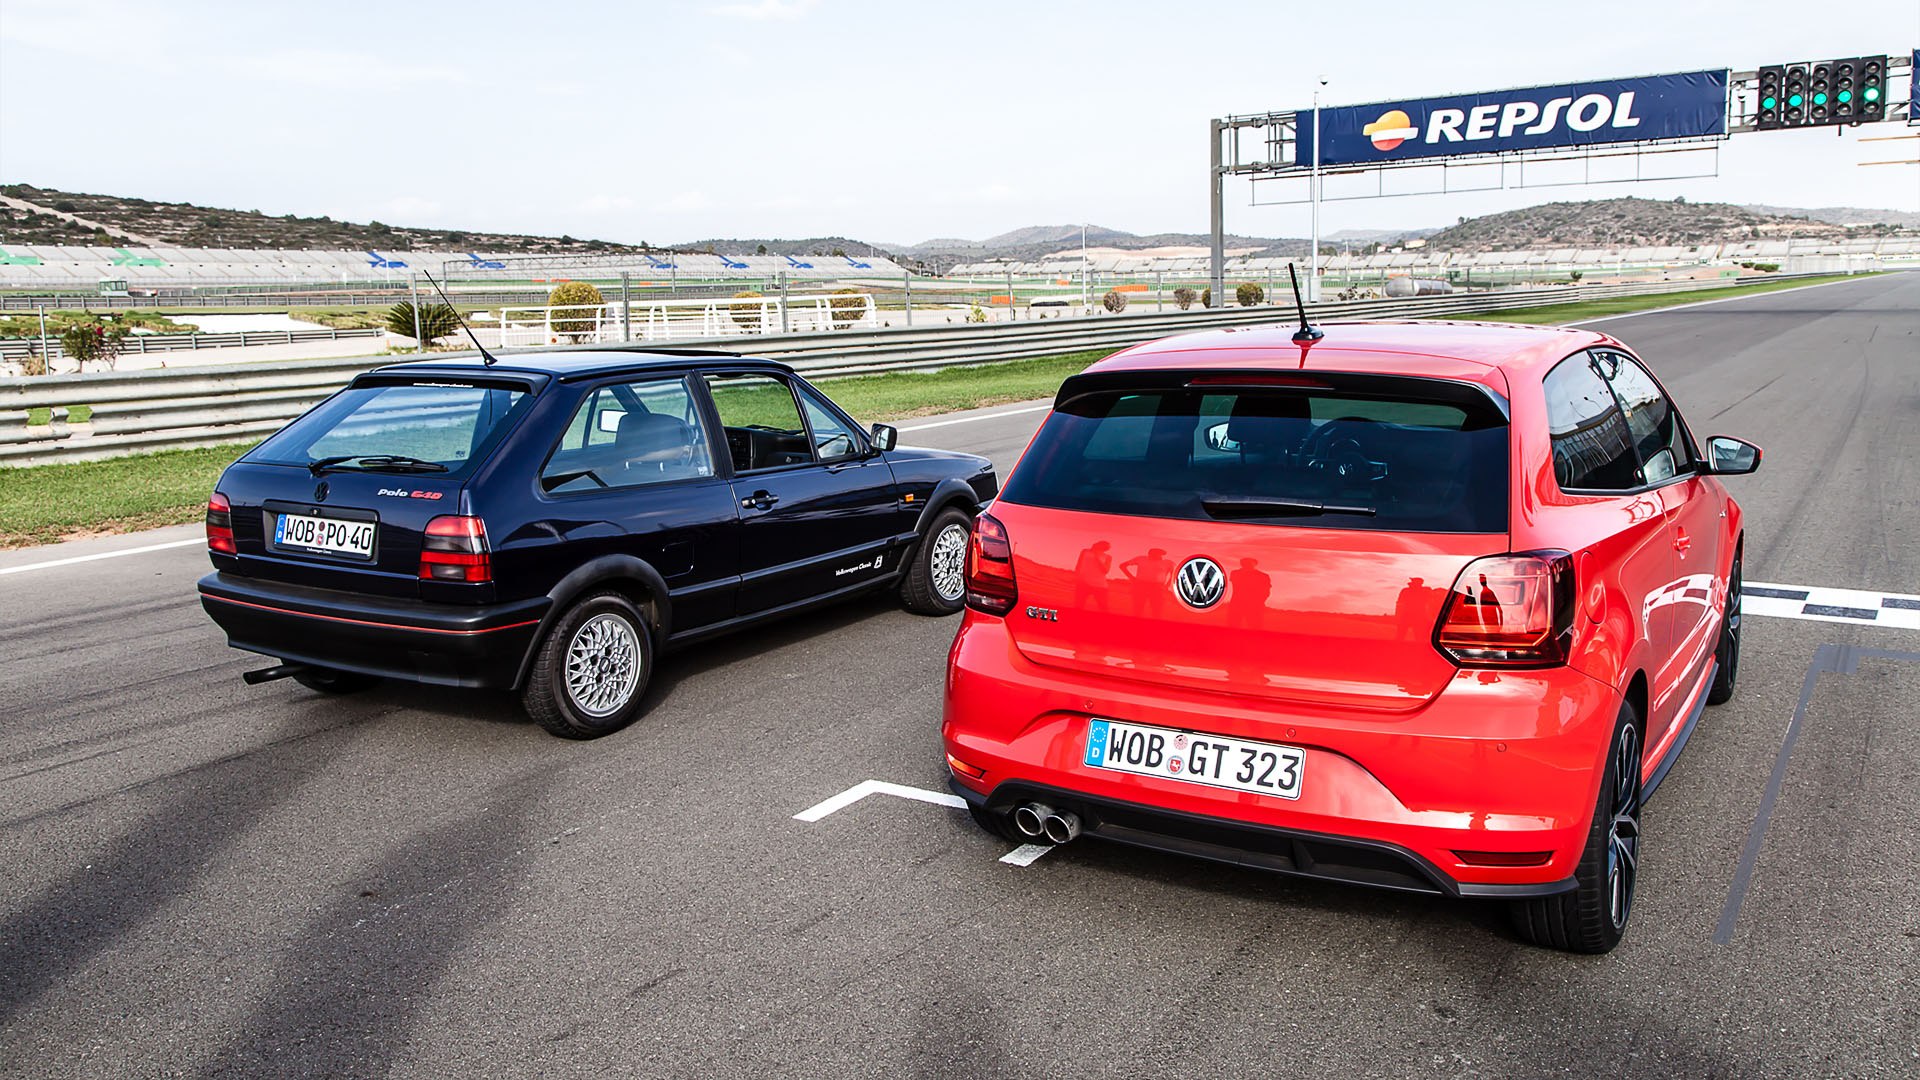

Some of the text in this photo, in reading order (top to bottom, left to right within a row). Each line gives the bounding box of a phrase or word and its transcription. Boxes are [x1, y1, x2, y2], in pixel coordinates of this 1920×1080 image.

[1425, 91, 1641, 144] REPSOL
[377, 488, 443, 499] Polo G40
[284, 517, 315, 543] WOB
[1026, 605, 1058, 622] GTI
[1091, 728, 1300, 790] D WOB GT 323
